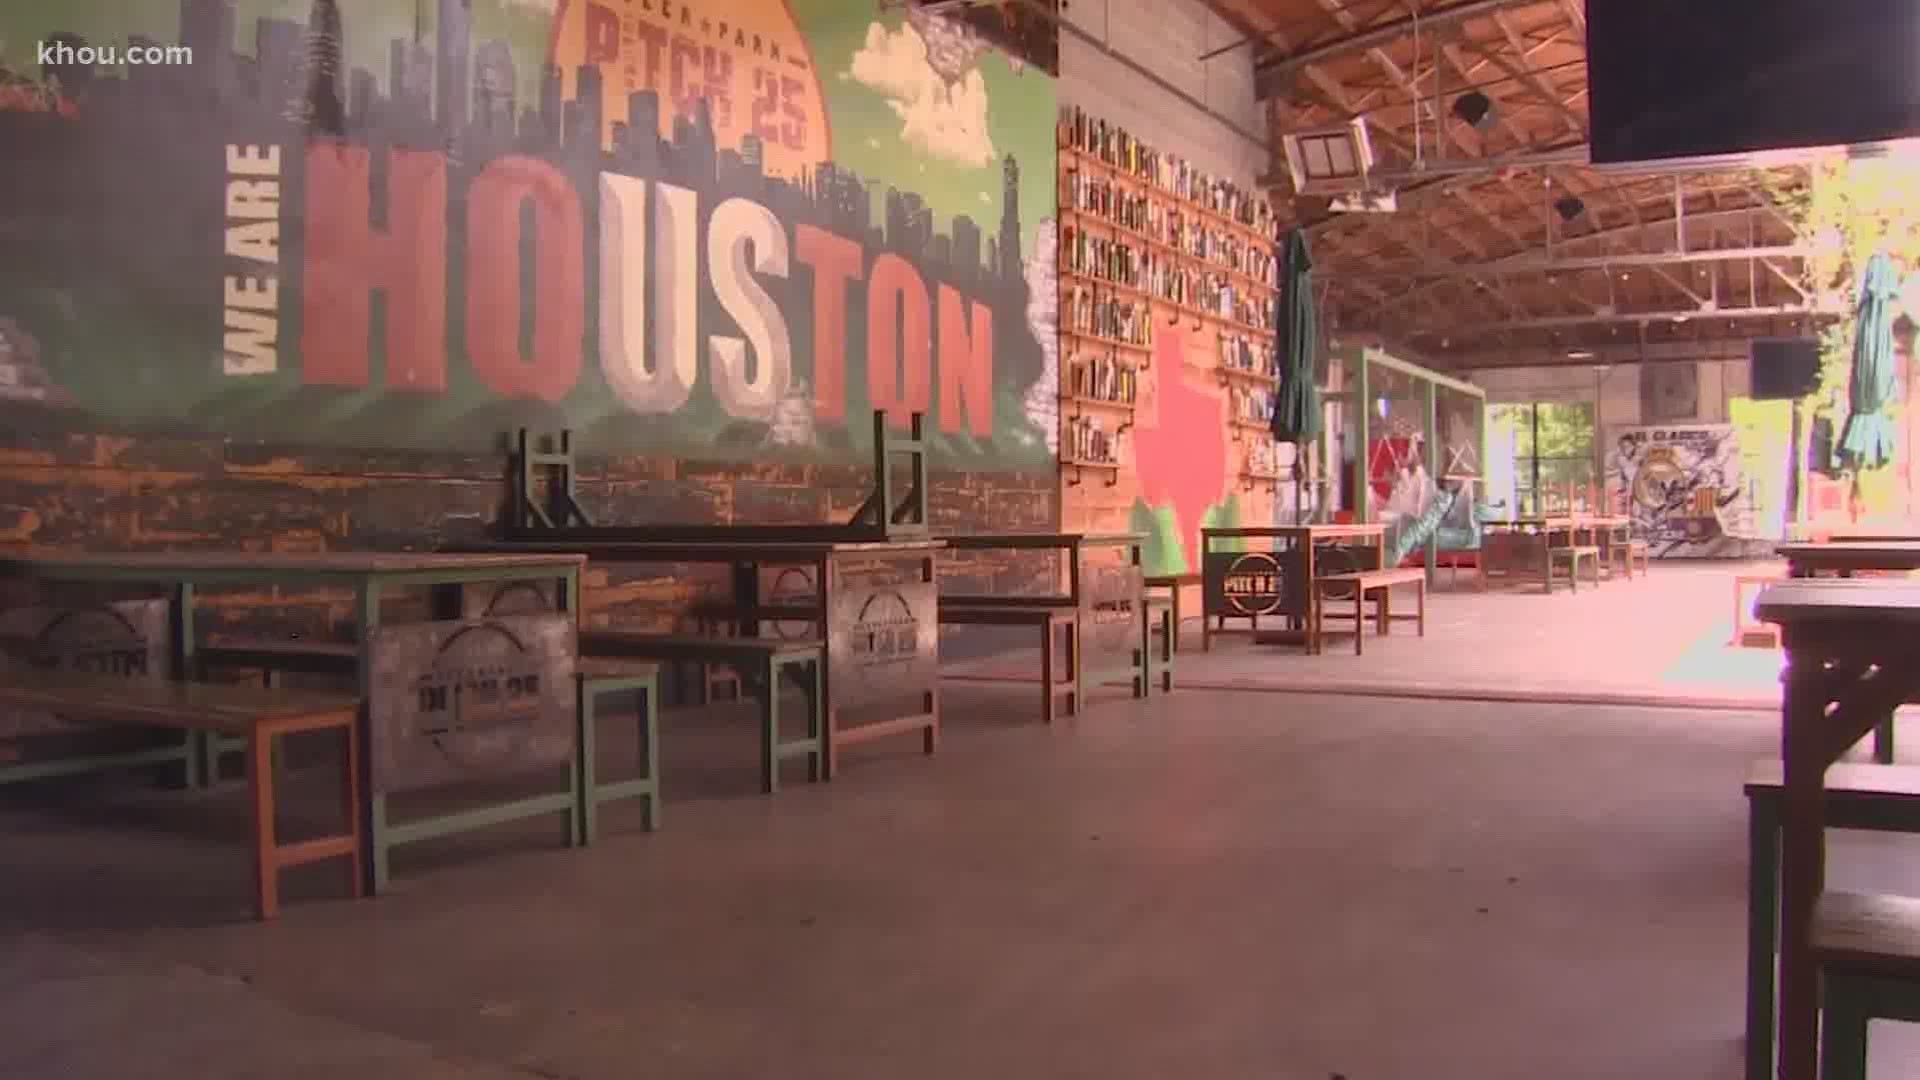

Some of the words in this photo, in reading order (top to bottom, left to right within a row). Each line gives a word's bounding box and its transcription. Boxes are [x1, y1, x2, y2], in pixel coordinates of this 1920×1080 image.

[225, 144, 280, 262] ARE
[223, 275, 279, 376] WE
[300, 138, 994, 439] HOUSTON
